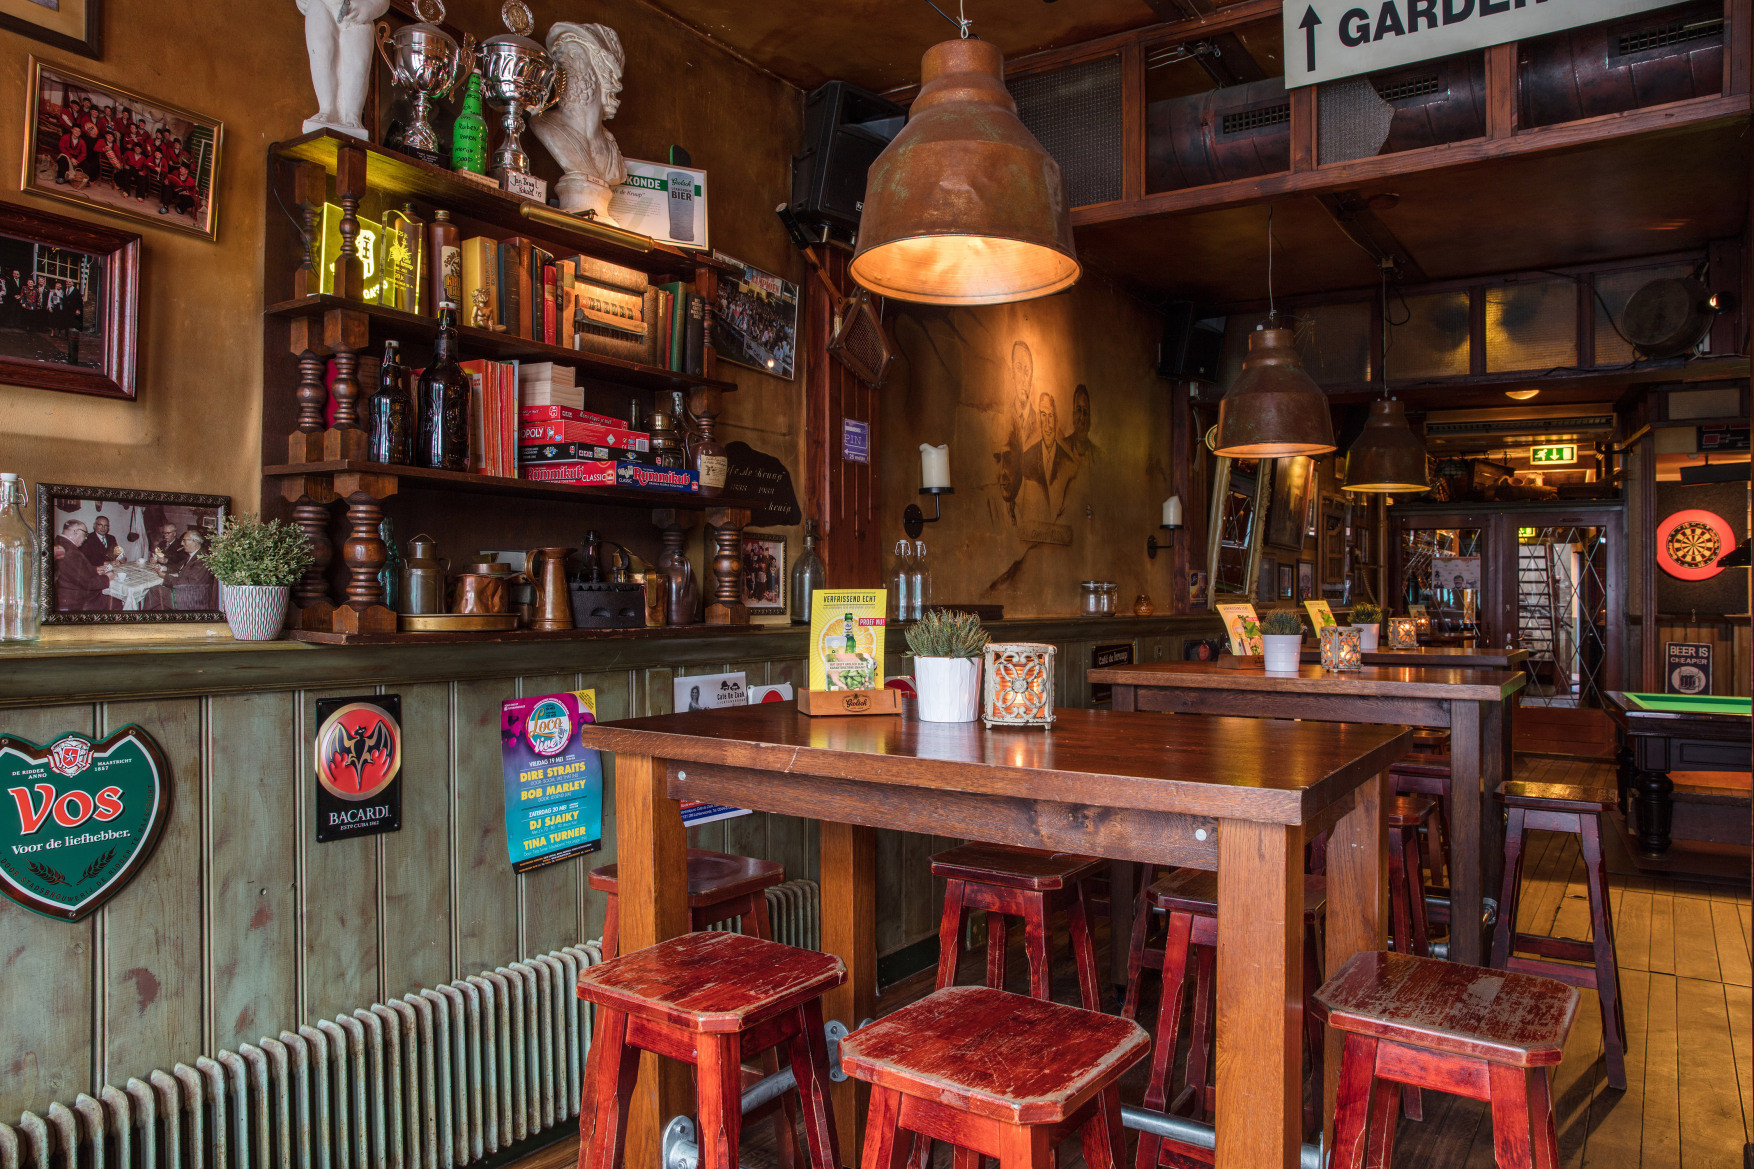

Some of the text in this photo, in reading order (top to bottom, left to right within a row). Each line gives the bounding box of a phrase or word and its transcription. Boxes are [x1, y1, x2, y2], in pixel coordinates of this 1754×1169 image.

[1338, 0, 1549, 47] GARD
[626, 175, 661, 189] KONDE
[671, 190, 692, 201] BIER
[520, 427, 544, 439] OPOLY
[844, 433, 862, 445] PIN
[528, 465, 607, 482] Rummikub CLASSIC
[633, 466, 690, 486] Rummikub
[824, 595, 876, 603] VERFRISSEND ECHT
[859, 618, 874, 626] PROEF
[1670, 645, 1709, 657] BEER IS
[1670, 657, 1708, 665] CHEAPER
[846, 698, 867, 708] Grolsch
[528, 707, 562, 738] Loco
[534, 736, 558, 753] live
[97, 758, 132, 767] MAASTRICHT
[529, 758, 548, 767] VRIJDAG
[520, 762, 586, 782] DIRE STRAITS
[521, 780, 586, 801] BOB MARLEY
[329, 805, 390, 826] BACARDI
[529, 809, 551, 818] ZATERDAG
[530, 810, 579, 830] DJ SJAIKY
[11, 829, 131, 855] Voor de liefhebber.
[523, 836, 547, 850] TINA
[549, 827, 586, 843] TURNER
[0, 858, 20, 877] DOOR
[20, 876, 94, 902] STADSBROUWERIJ
[96, 877, 107, 889] DE
[108, 849, 132, 876] RIDDER
